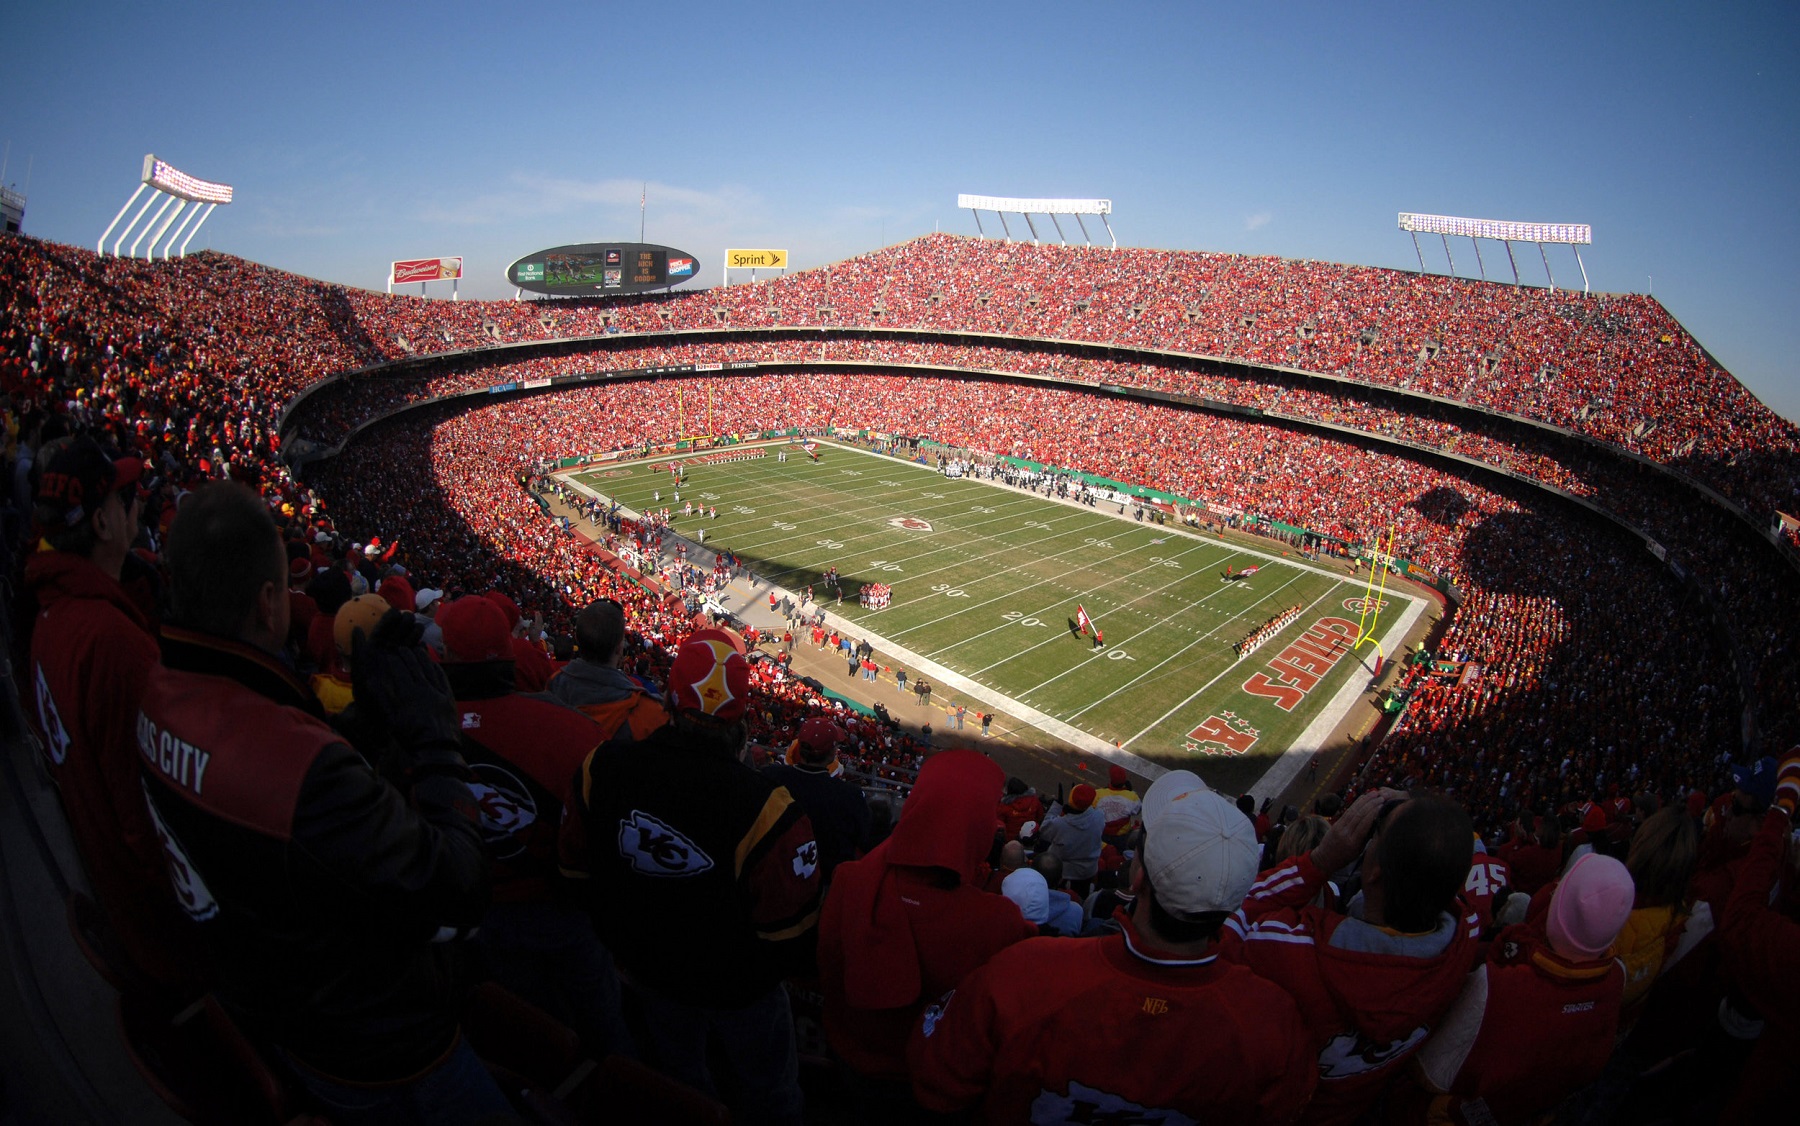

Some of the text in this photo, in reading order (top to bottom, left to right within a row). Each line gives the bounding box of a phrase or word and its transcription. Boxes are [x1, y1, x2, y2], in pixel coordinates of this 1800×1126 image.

[733, 253, 765, 266] Sprint
[395, 264, 437, 278] Budweiser
[669, 264, 691, 275] CHOPPER
[492, 385, 507, 393] HCA
[816, 538, 844, 550] 50
[931, 583, 965, 597] 30
[1001, 611, 1040, 627] 20
[1241, 616, 1364, 713] CHIEFS
[159, 728, 211, 795] CITY
[1464, 863, 1507, 896] 45
[1141, 996, 1169, 1016] NFL
